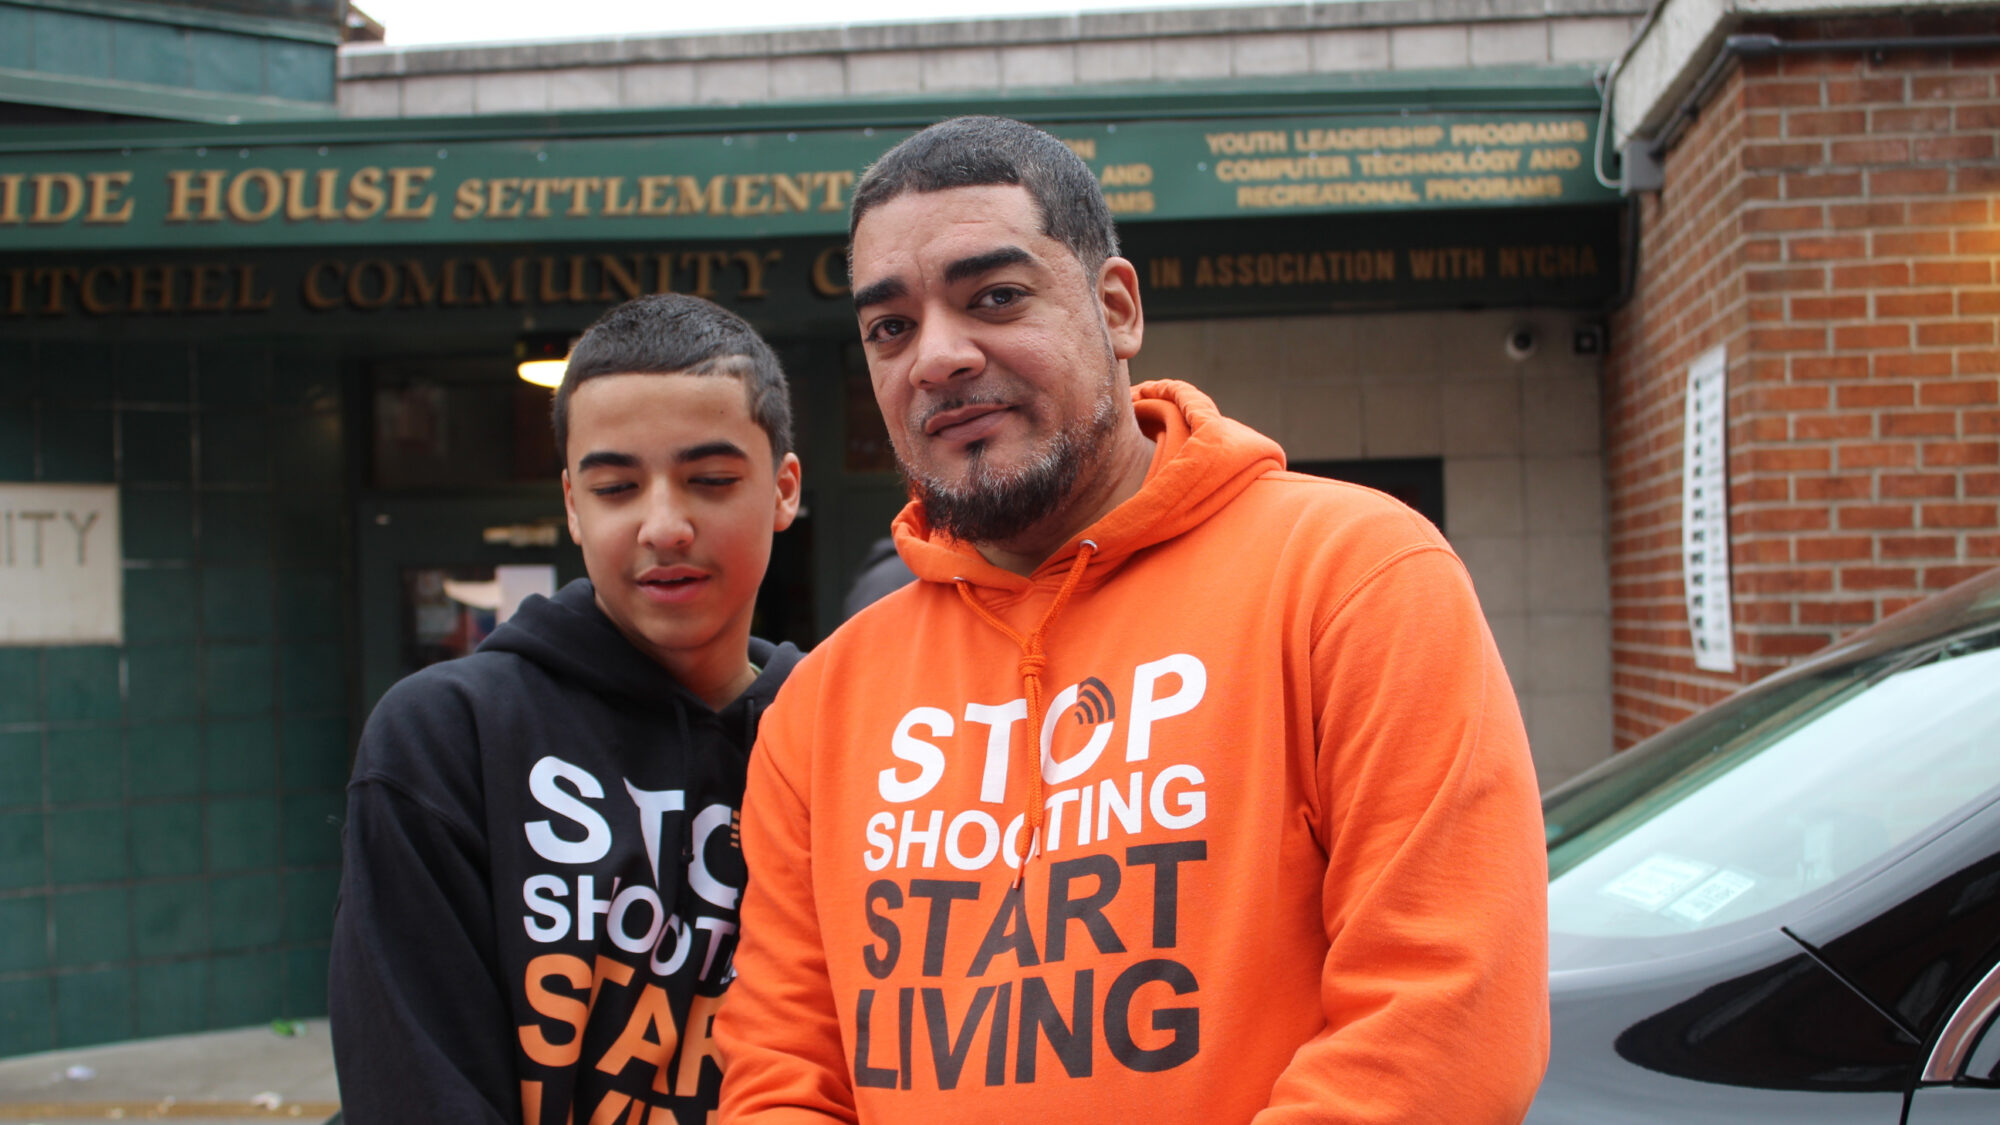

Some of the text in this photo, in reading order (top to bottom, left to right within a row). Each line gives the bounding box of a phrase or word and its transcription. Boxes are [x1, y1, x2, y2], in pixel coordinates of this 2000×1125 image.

[1101, 164, 1153, 187] AND
[1205, 121, 1588, 155] YOUTH LEADERSHIP PROGRAMS
[1215, 147, 1581, 182] COMPUTER TECHNOLOGY AND
[0, 167, 854, 224] IDE HOUSE SETTLEMENT
[1236, 175, 1562, 208] RECREATIONAL PROGRAMS
[303, 250, 782, 309] COMMUNITY
[1150, 245, 1598, 289] IN ASSOCIATION WITH NYCHA
[878, 653, 1207, 803] STOP
[524, 756, 740, 910] STO
[863, 764, 1206, 871] SHOOTING
[523, 874, 738, 985] SHOOT
[862, 840, 1207, 979] START
[518, 953, 727, 1097] STAR
[854, 958, 1200, 1090] LIVING
